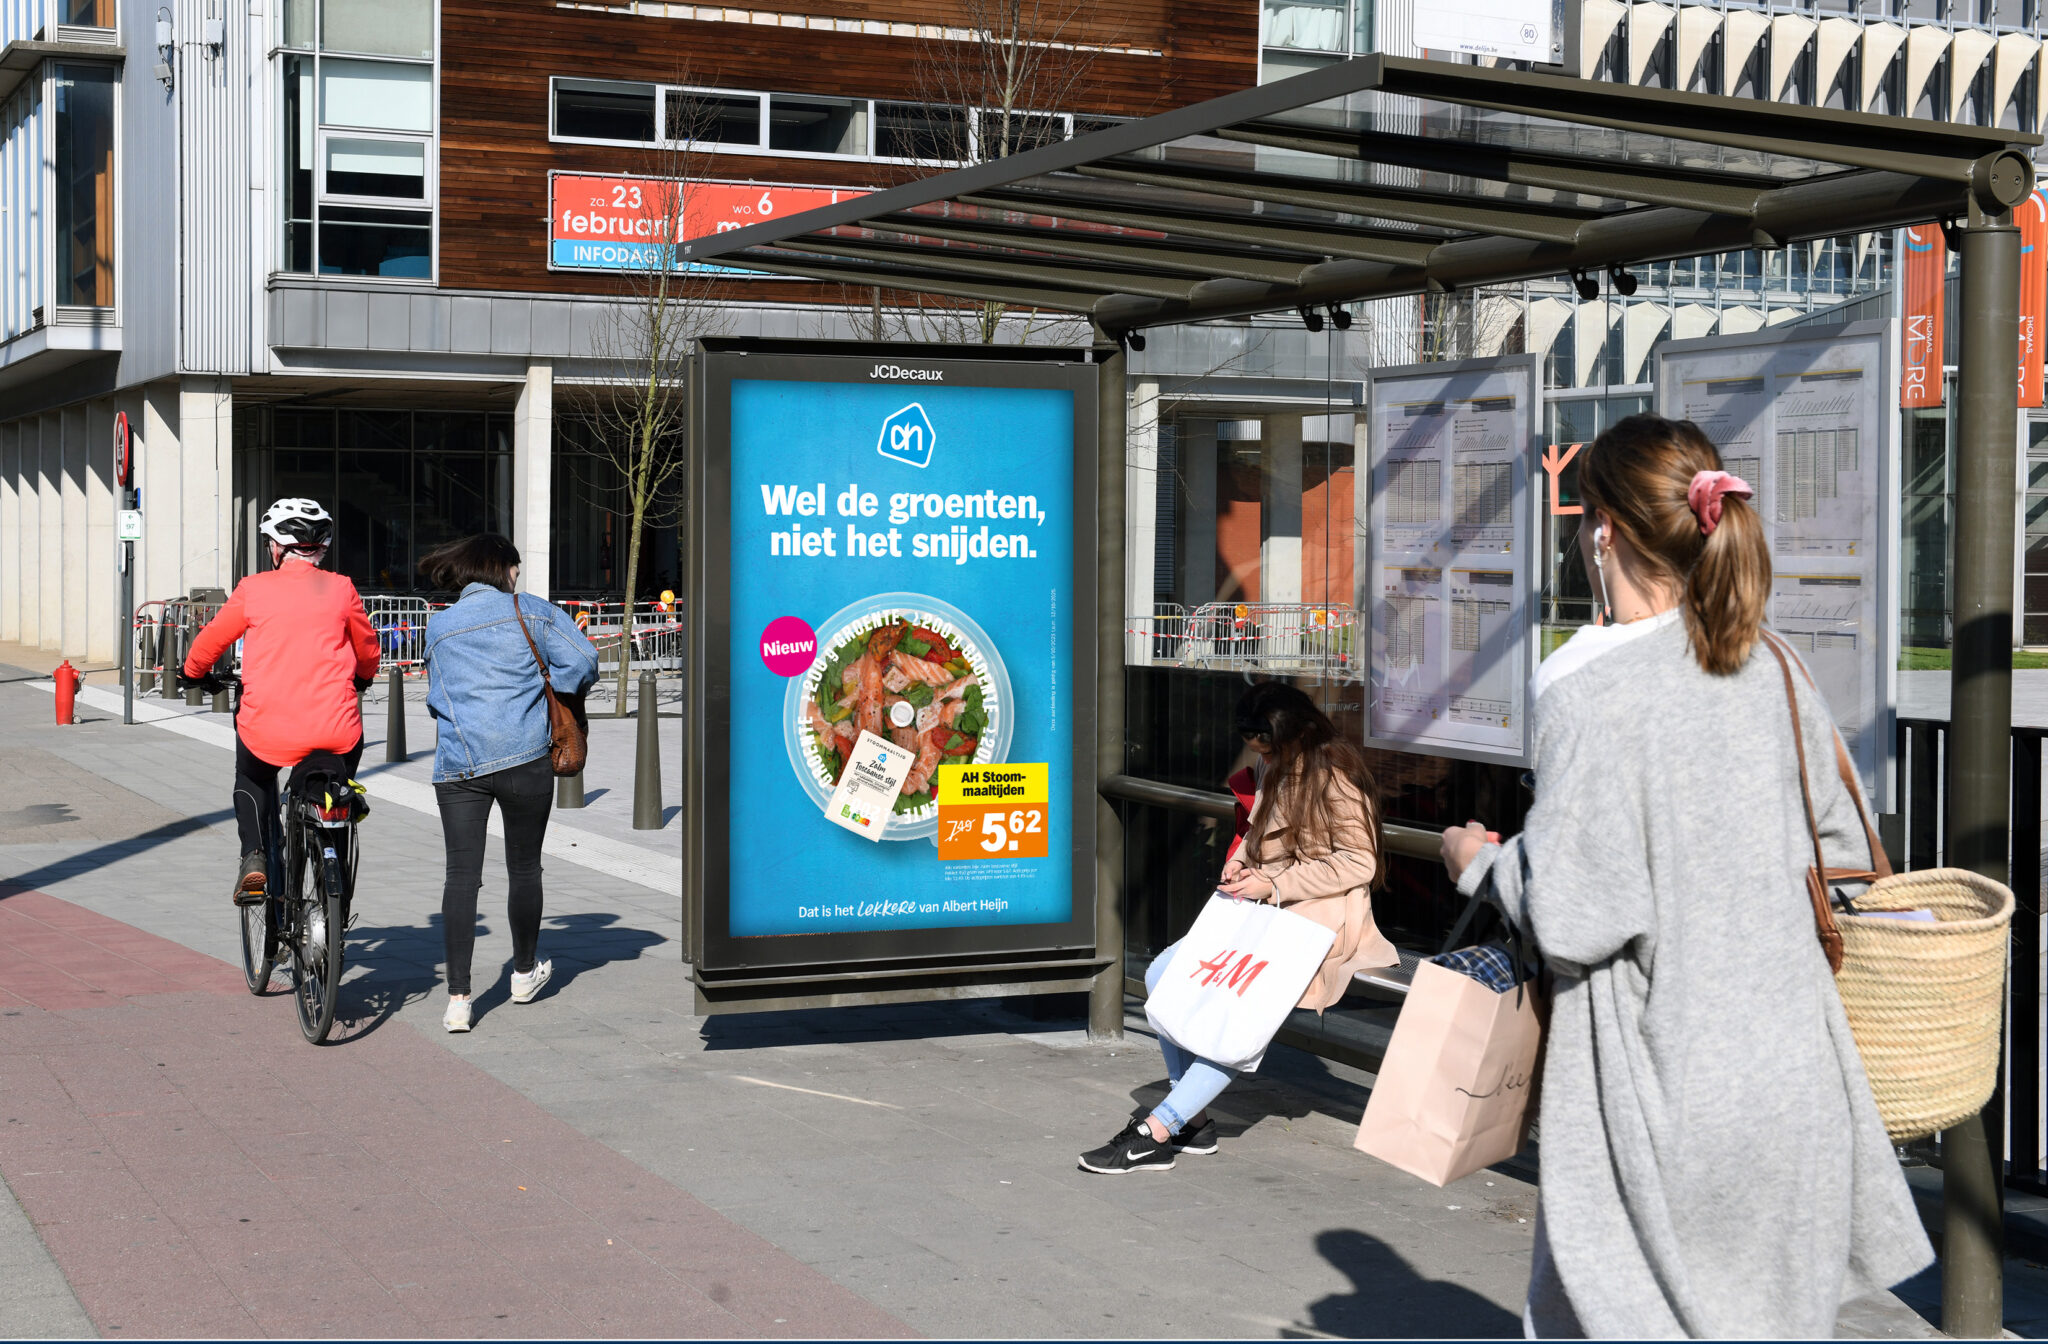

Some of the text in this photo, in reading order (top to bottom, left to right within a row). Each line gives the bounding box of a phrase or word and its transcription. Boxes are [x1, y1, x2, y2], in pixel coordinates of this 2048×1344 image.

[1523, 29, 1534, 39] 80
[590, 185, 643, 209] za. 23
[732, 191, 774, 215] wo. 6
[562, 209, 669, 237] februari
[573, 246, 659, 264] INFODAG
[1926, 315, 1934, 353] THOMAS
[2026, 316, 2035, 354] THOMAS
[869, 364, 944, 381] JCDecaux
[760, 483, 1046, 526] Wel de groenten,
[770, 524, 1037, 565] niet het snijden.
[833, 608, 900, 650] GROENTE
[763, 640, 814, 657] Nieuw
[961, 639, 999, 713] GROENTE
[797, 715, 834, 789] GROENTE
[869, 759, 887, 773] Zalm
[961, 771, 1027, 783] AH Stoom-
[962, 784, 1025, 798] maaltijden
[798, 905, 820, 918] Dat
[822, 905, 832, 917] is
[834, 905, 854, 917] het
[918, 901, 940, 913] van
[942, 900, 978, 913] Albert
[979, 898, 1009, 913] Heijn
[1189, 949, 1270, 998] H&M
